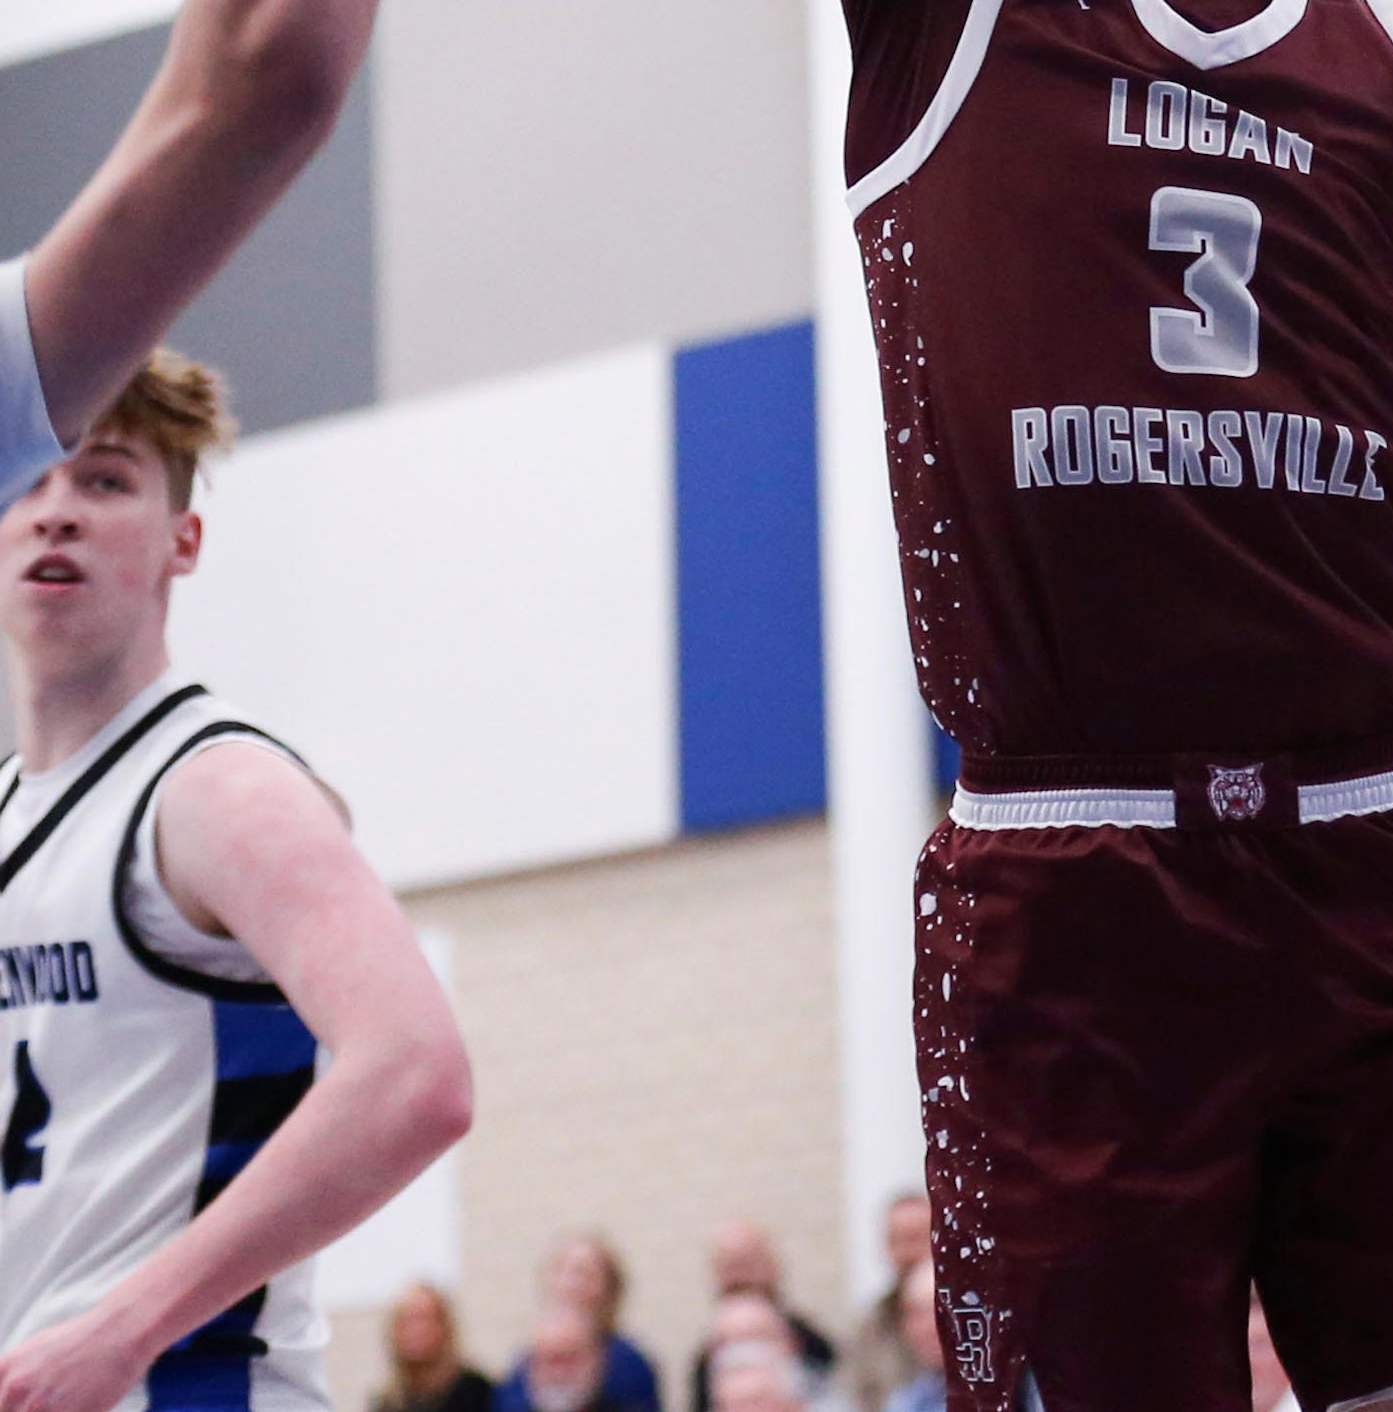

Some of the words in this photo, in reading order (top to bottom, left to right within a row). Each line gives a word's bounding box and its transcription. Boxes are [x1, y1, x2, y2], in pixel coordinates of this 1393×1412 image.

[1109, 79, 1314, 175] LOGAN
[1149, 186, 1262, 378] 3
[1012, 405, 1388, 501] ROGERSVILLE
